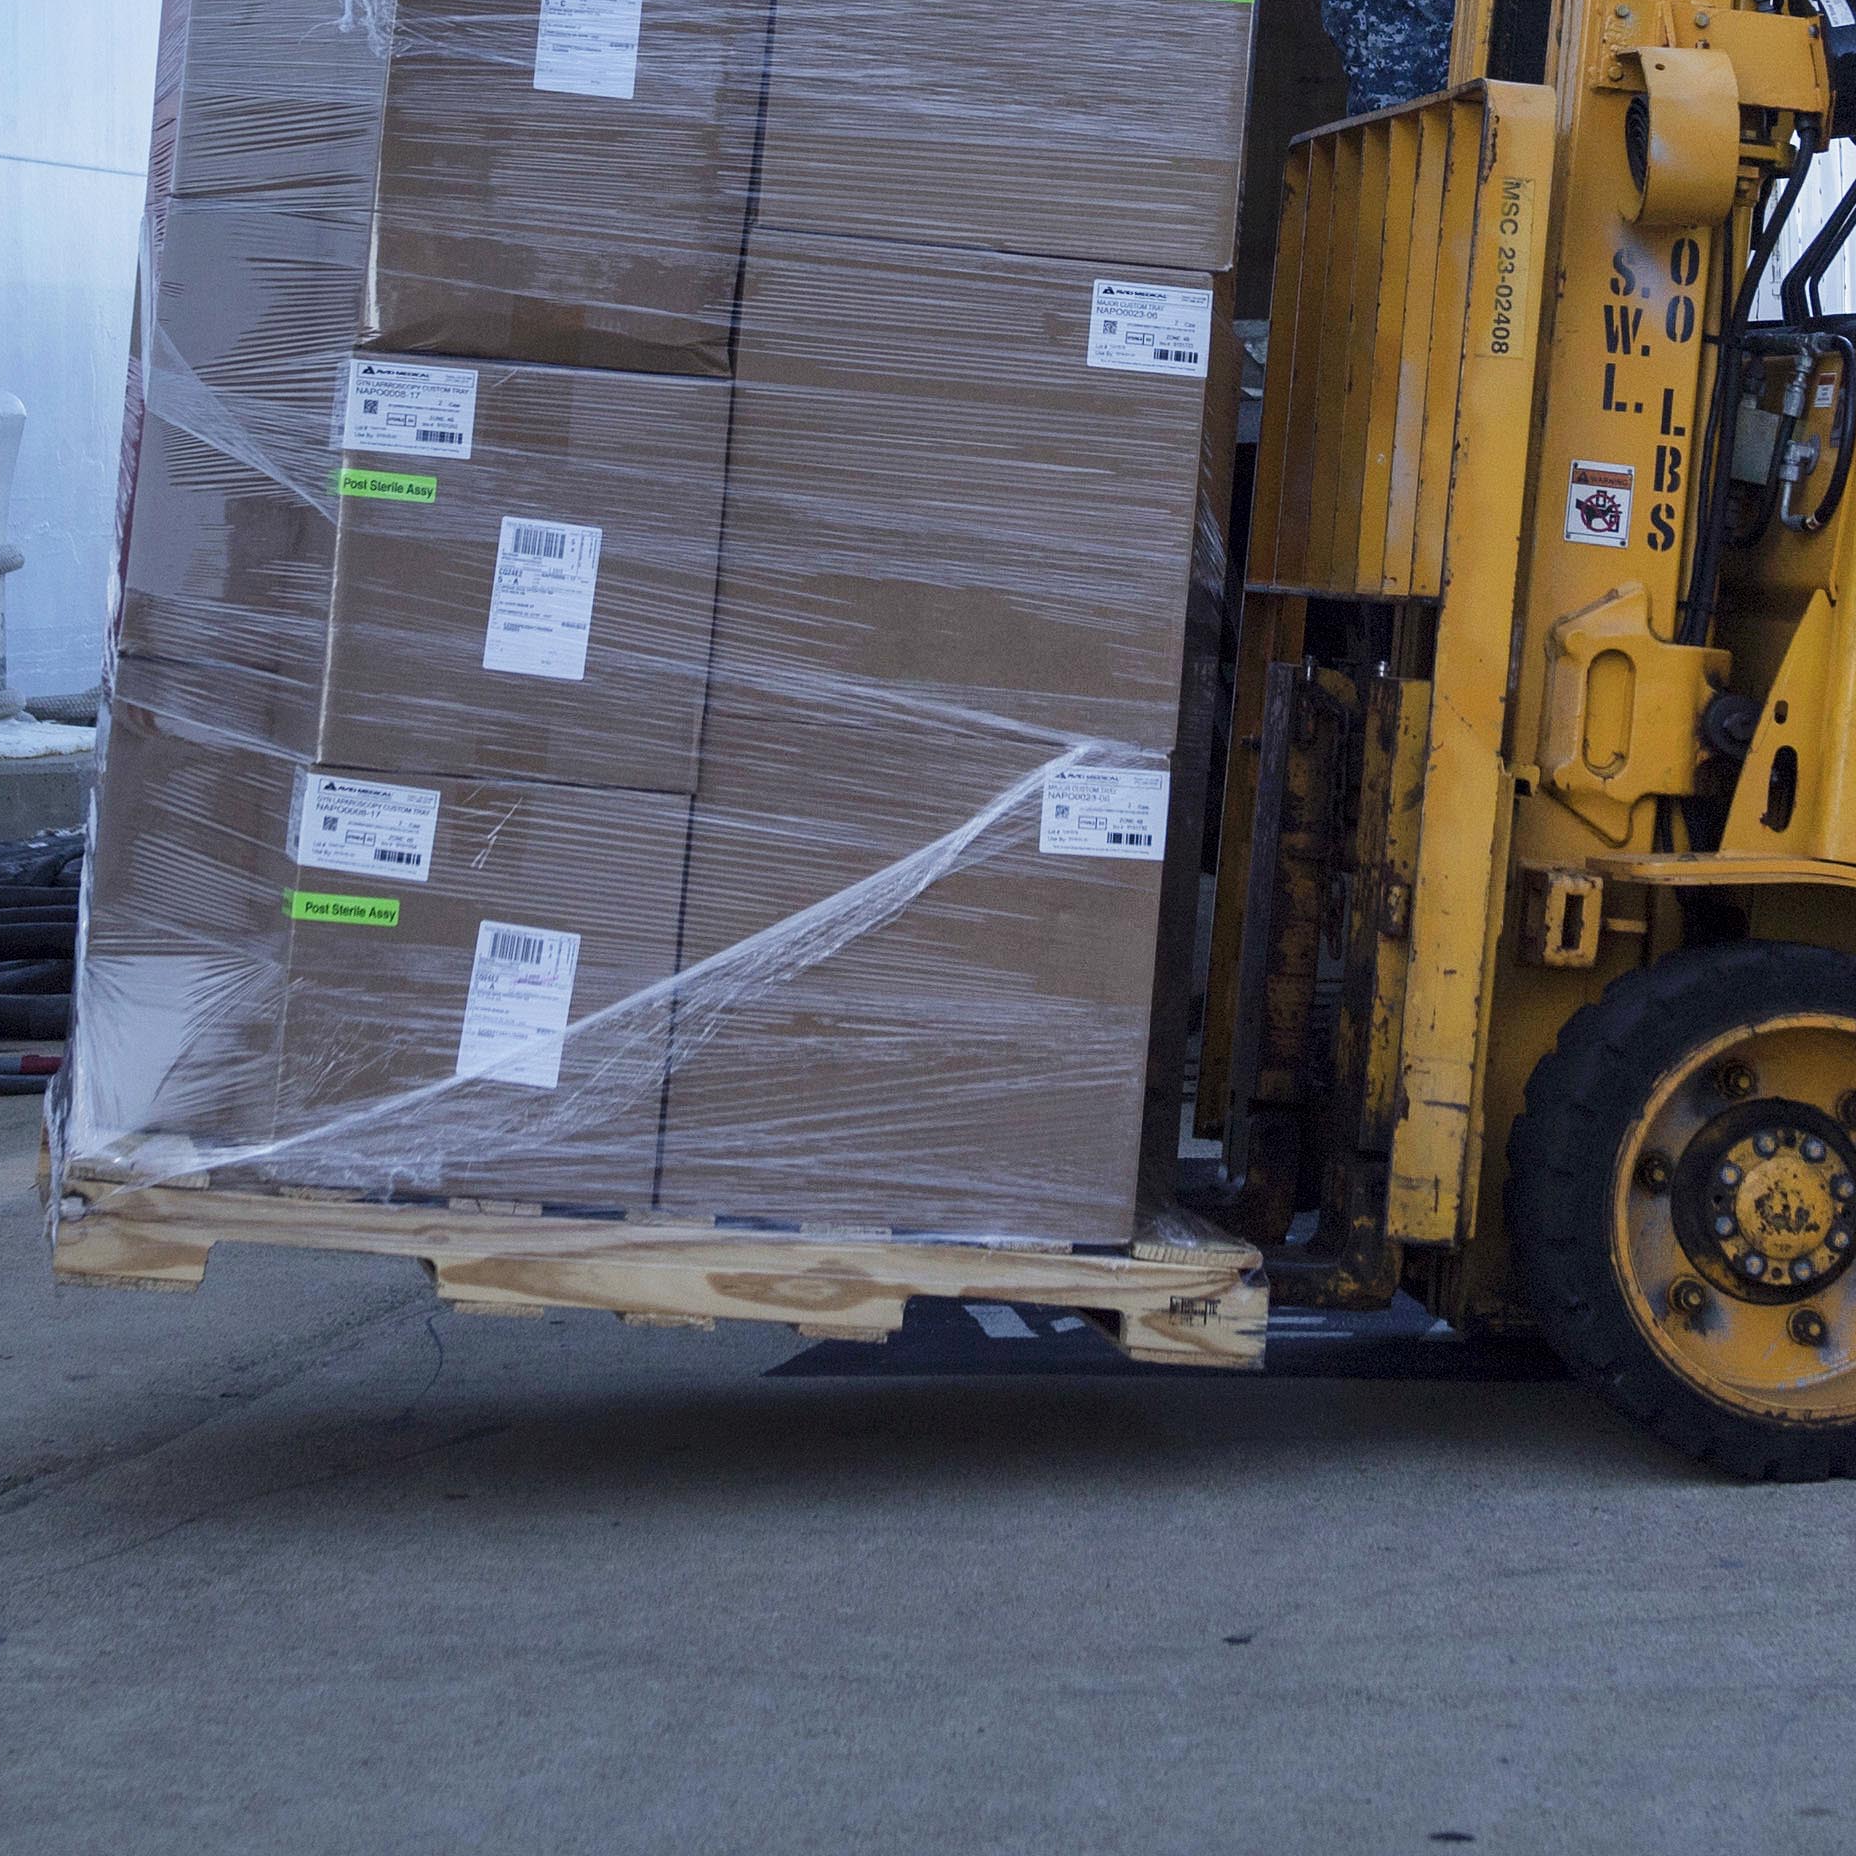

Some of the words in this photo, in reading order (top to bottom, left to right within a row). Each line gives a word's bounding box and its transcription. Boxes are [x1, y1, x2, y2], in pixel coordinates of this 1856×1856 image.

[1500, 176, 1521, 235] MSC
[1097, 299, 1119, 307] MAJOR
[1120, 302, 1147, 310] CUSTOM
[1491, 247, 1516, 355] 23-02408
[423, 385, 451, 393] CUSTOM
[344, 477, 367, 490] Post
[370, 480, 404, 494] Sterile
[406, 483, 434, 499] Assy
[305, 901, 329, 913] Post
[332, 903, 366, 917] Sterile
[368, 906, 396, 922] Assy
